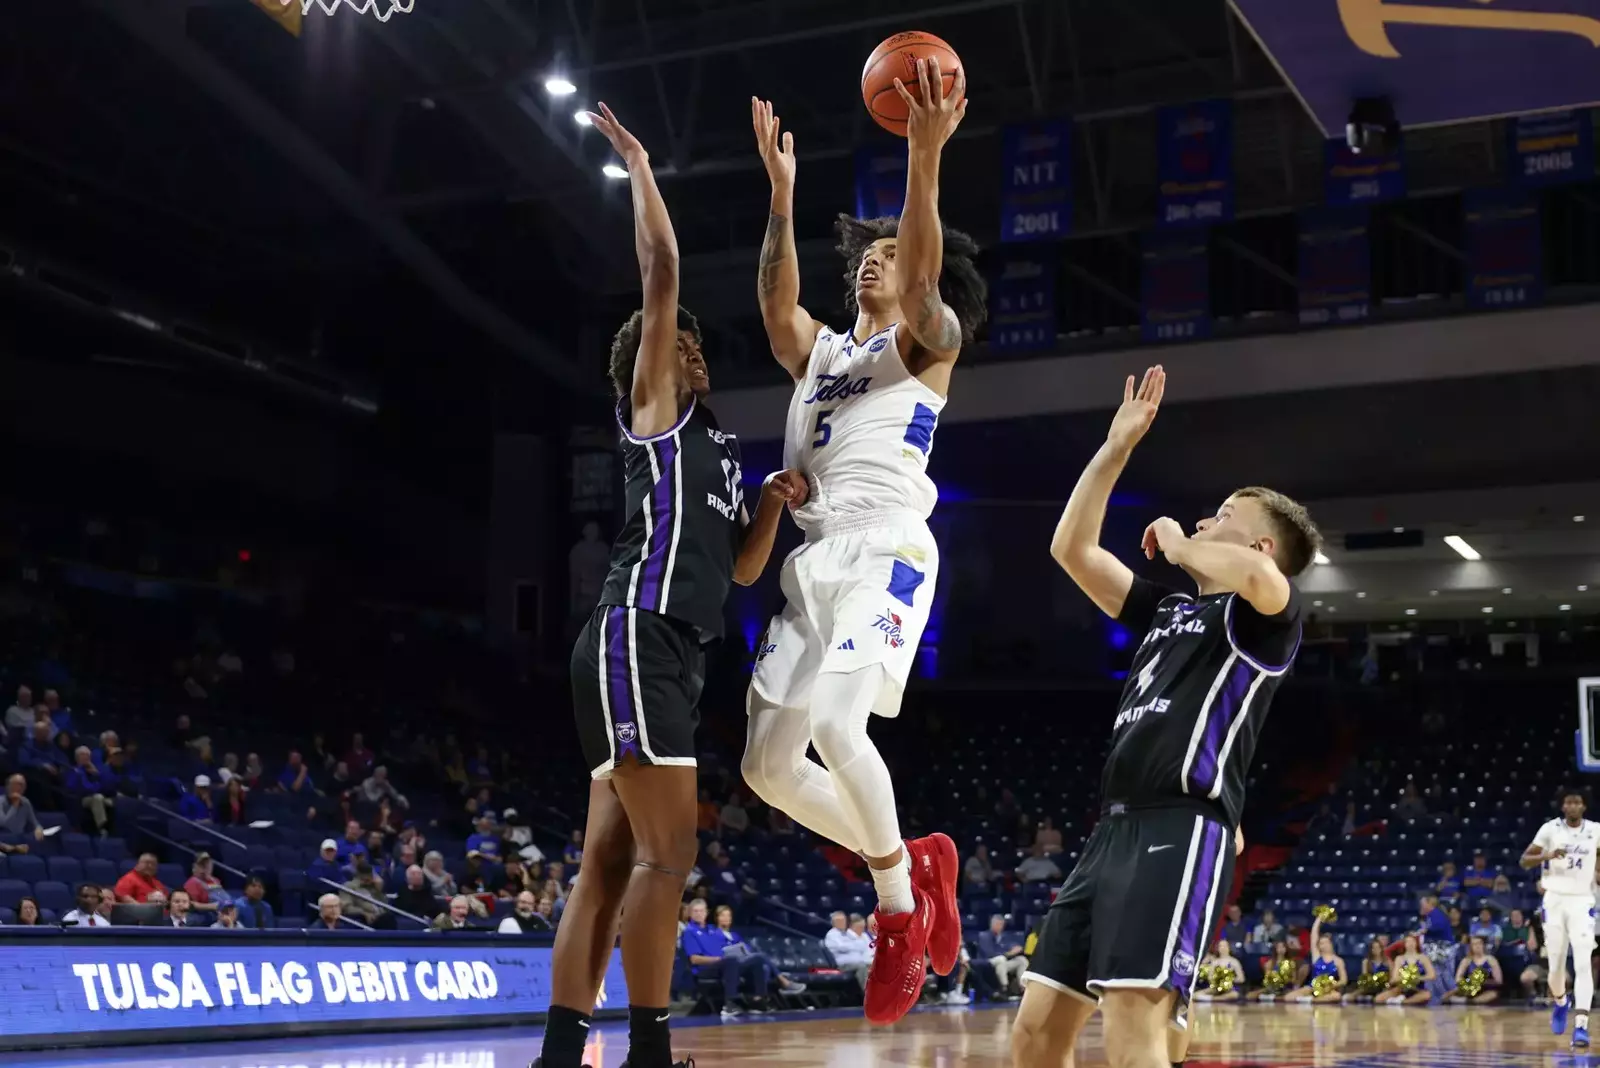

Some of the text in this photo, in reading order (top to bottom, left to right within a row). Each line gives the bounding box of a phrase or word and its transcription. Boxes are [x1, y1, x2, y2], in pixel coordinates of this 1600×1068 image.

[1013, 161, 1060, 186] NIT
[1012, 209, 1060, 235] 2001
[804, 374, 872, 404] Tulsa
[812, 410, 836, 449] 5
[871, 614, 905, 648] Tulsa
[1567, 857, 1582, 870] 34
[72, 961, 498, 1011] TULSA FLAG DEBIT CARD
